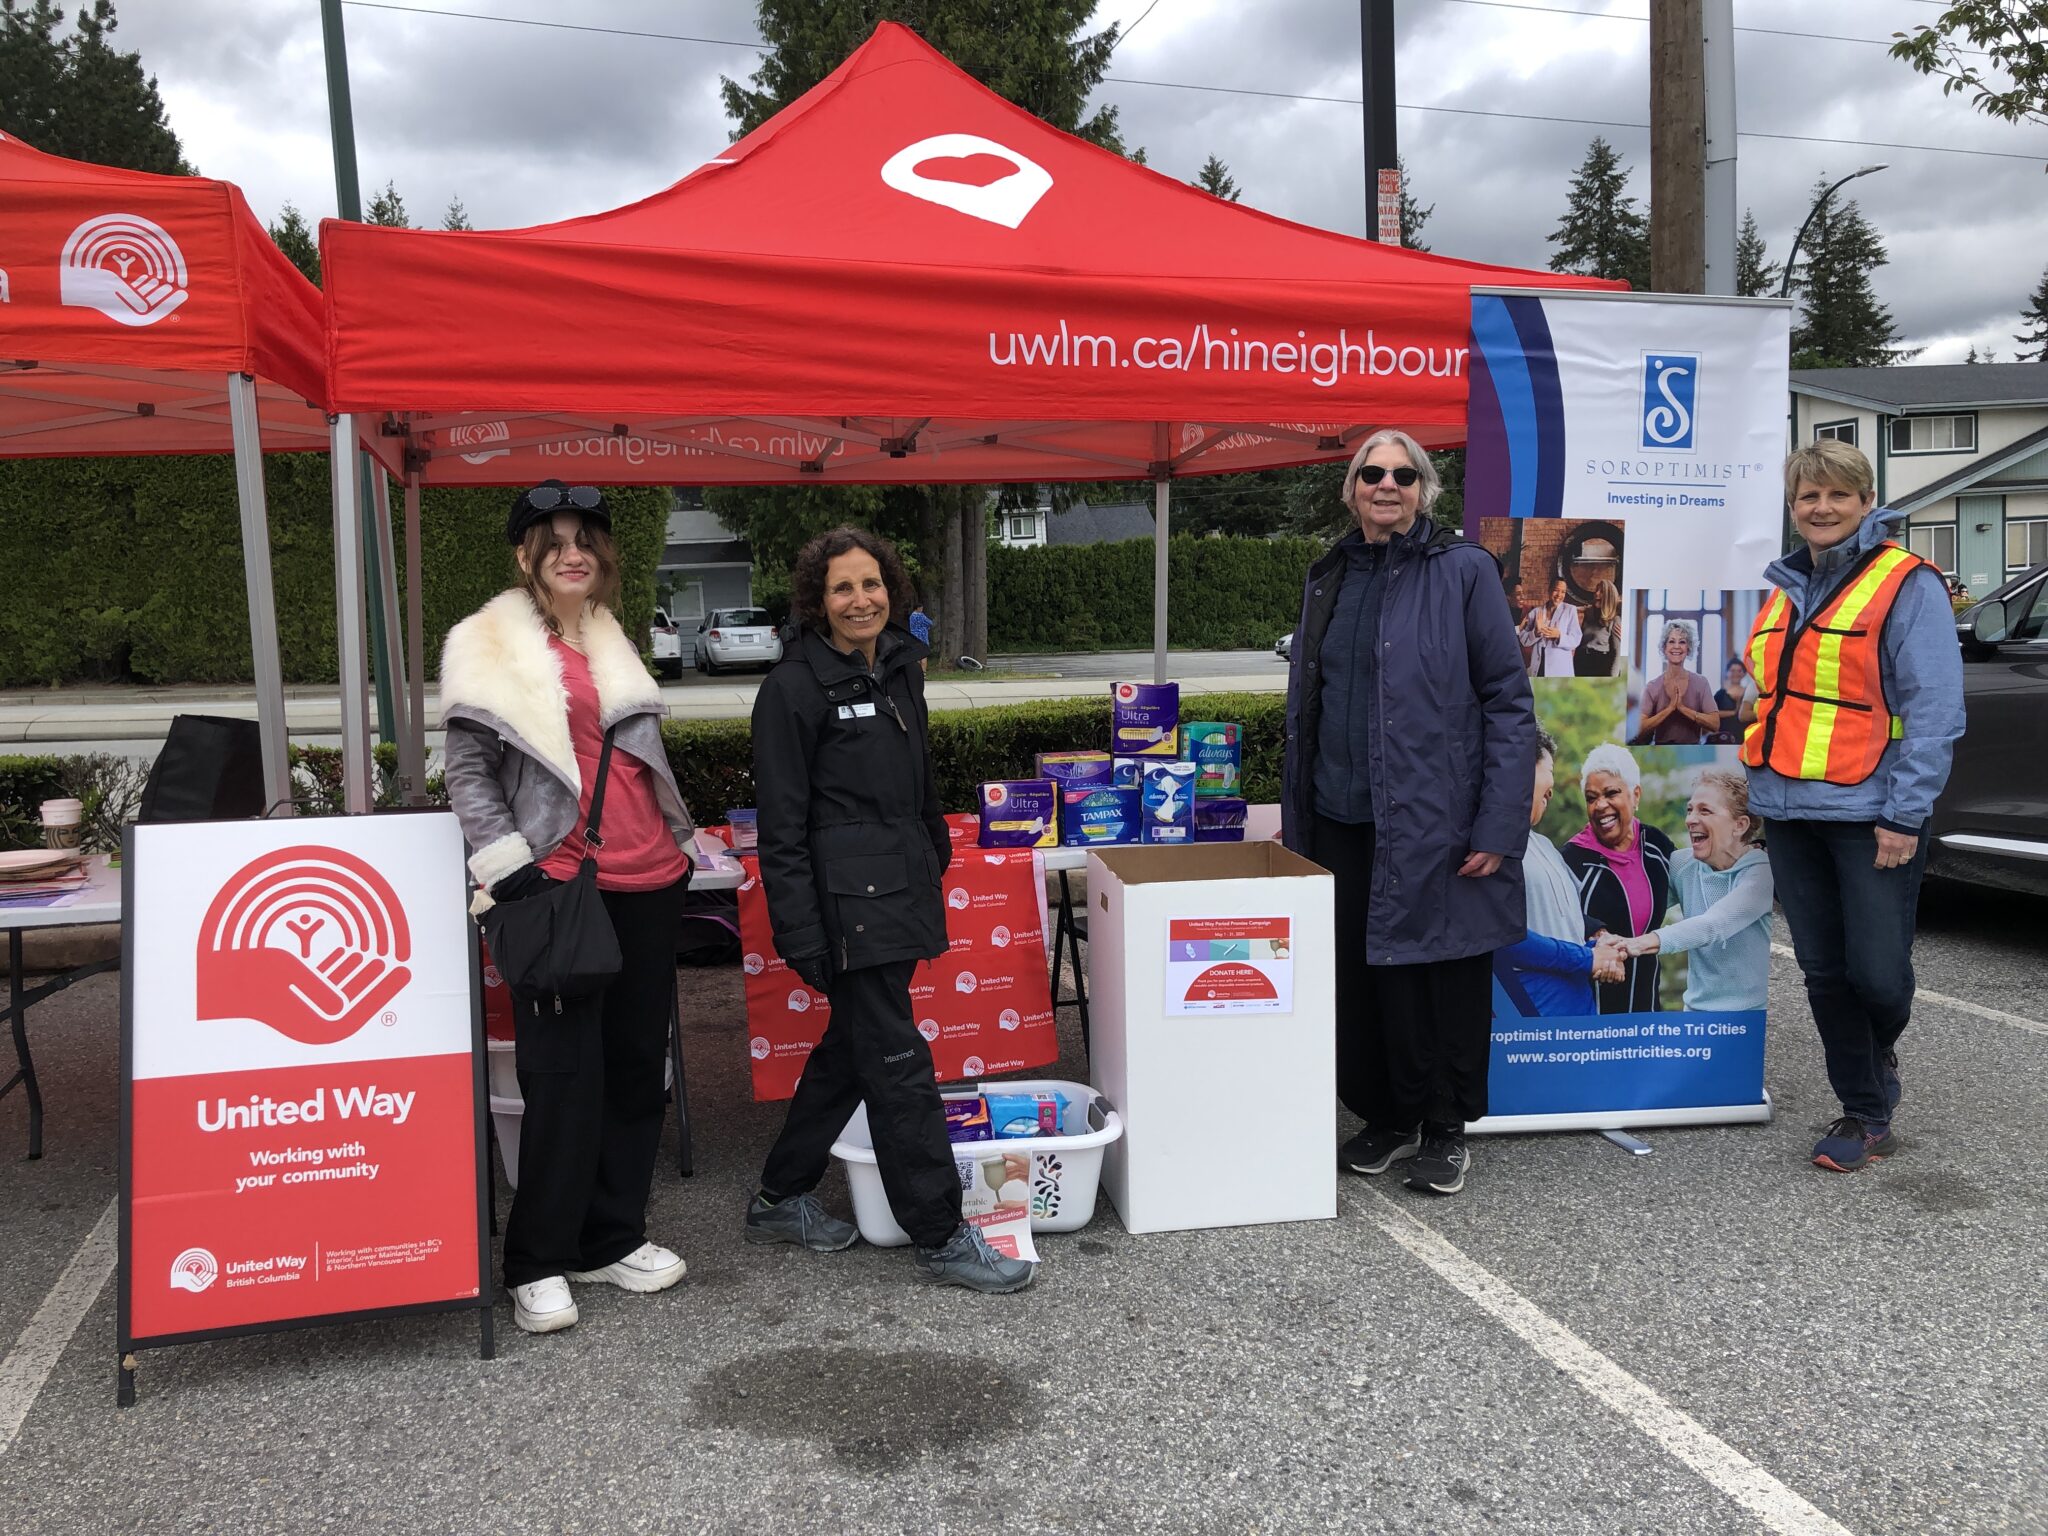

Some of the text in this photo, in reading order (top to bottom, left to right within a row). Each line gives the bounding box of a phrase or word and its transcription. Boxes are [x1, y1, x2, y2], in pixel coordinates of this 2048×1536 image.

[989, 319, 1469, 387] uwlm.ca/hineighbour
[1608, 492, 1726, 508] Investing in Dreams
[1121, 710, 1150, 720] Ultra
[1198, 745, 1234, 761] always
[1010, 798, 1039, 808] Ultra
[1081, 808, 1122, 822] TAMPAX
[972, 893, 1008, 902] United Way
[1014, 930, 1034, 939] United
[958, 938, 973, 946] Way
[767, 958, 786, 966] Unite
[980, 976, 1014, 986] United Way
[921, 985, 935, 993] Way
[813, 996, 828, 1004] Unit
[1023, 1013, 1044, 1022] United
[942, 1022, 980, 1033] United Way
[1490, 1023, 1747, 1044] roptimist International of the Tri Cities
[774, 1041, 813, 1051] United Way
[1506, 1045, 1712, 1065] www.soroptimisttricities.org
[987, 1062, 1009, 1070] United
[197, 1085, 416, 1132] United Way
[250, 1141, 366, 1166] Working with
[235, 1162, 380, 1193] your community
[980, 1217, 990, 1225] for
[991, 1210, 1024, 1221] Education
[326, 1249, 356, 1258] Working
[374, 1243, 418, 1252] communities
[326, 1246, 440, 1265] Interior, Lower Mainland, Central
[226, 1255, 308, 1275] United Way
[334, 1261, 367, 1271] Northern
[368, 1257, 404, 1267] Vancouver
[405, 1254, 426, 1263] Island
[226, 1272, 300, 1288] British Columbia
